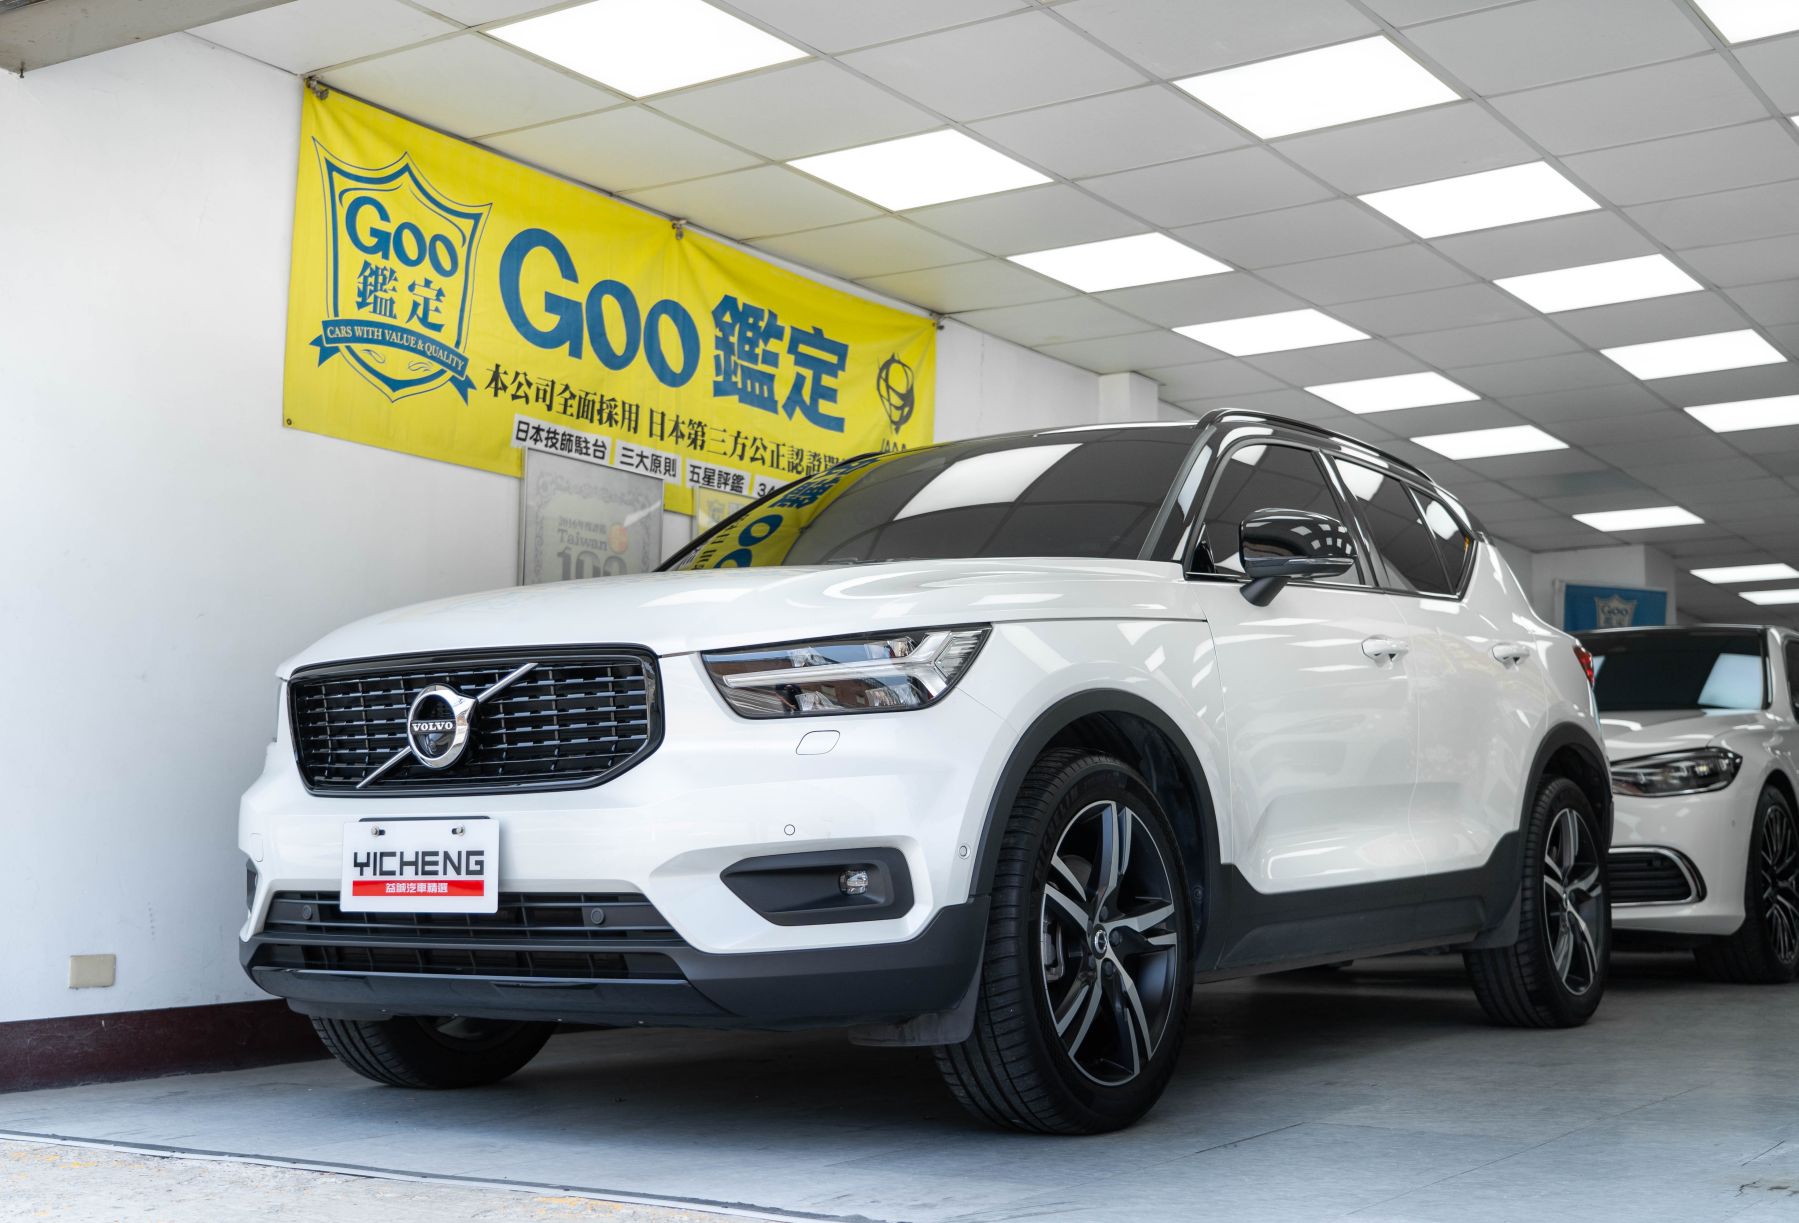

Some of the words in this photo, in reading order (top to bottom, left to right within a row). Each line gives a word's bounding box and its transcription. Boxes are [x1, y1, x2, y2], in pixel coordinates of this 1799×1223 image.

[345, 196, 459, 278] Goo
[355, 259, 447, 333] 鑑定
[499, 227, 700, 388] Goo
[711, 293, 850, 434] 鑑定
[326, 326, 353, 338] CARS
[354, 326, 383, 340] WITH
[384, 329, 418, 349] VALUE
[417, 338, 425, 350] &
[424, 343, 465, 371] QUALITY
[484, 363, 641, 434] 本公司全面採用
[649, 407, 846, 476] 日本第三方公正認證單
[515, 420, 607, 462] 日本技師駐台
[619, 447, 678, 478] 三大原則
[689, 463, 745, 494] 五星評鑑
[557, 529, 608, 551] Taiwan
[412, 721, 454, 732] VOLVO
[353, 850, 485, 876] YICHENG
